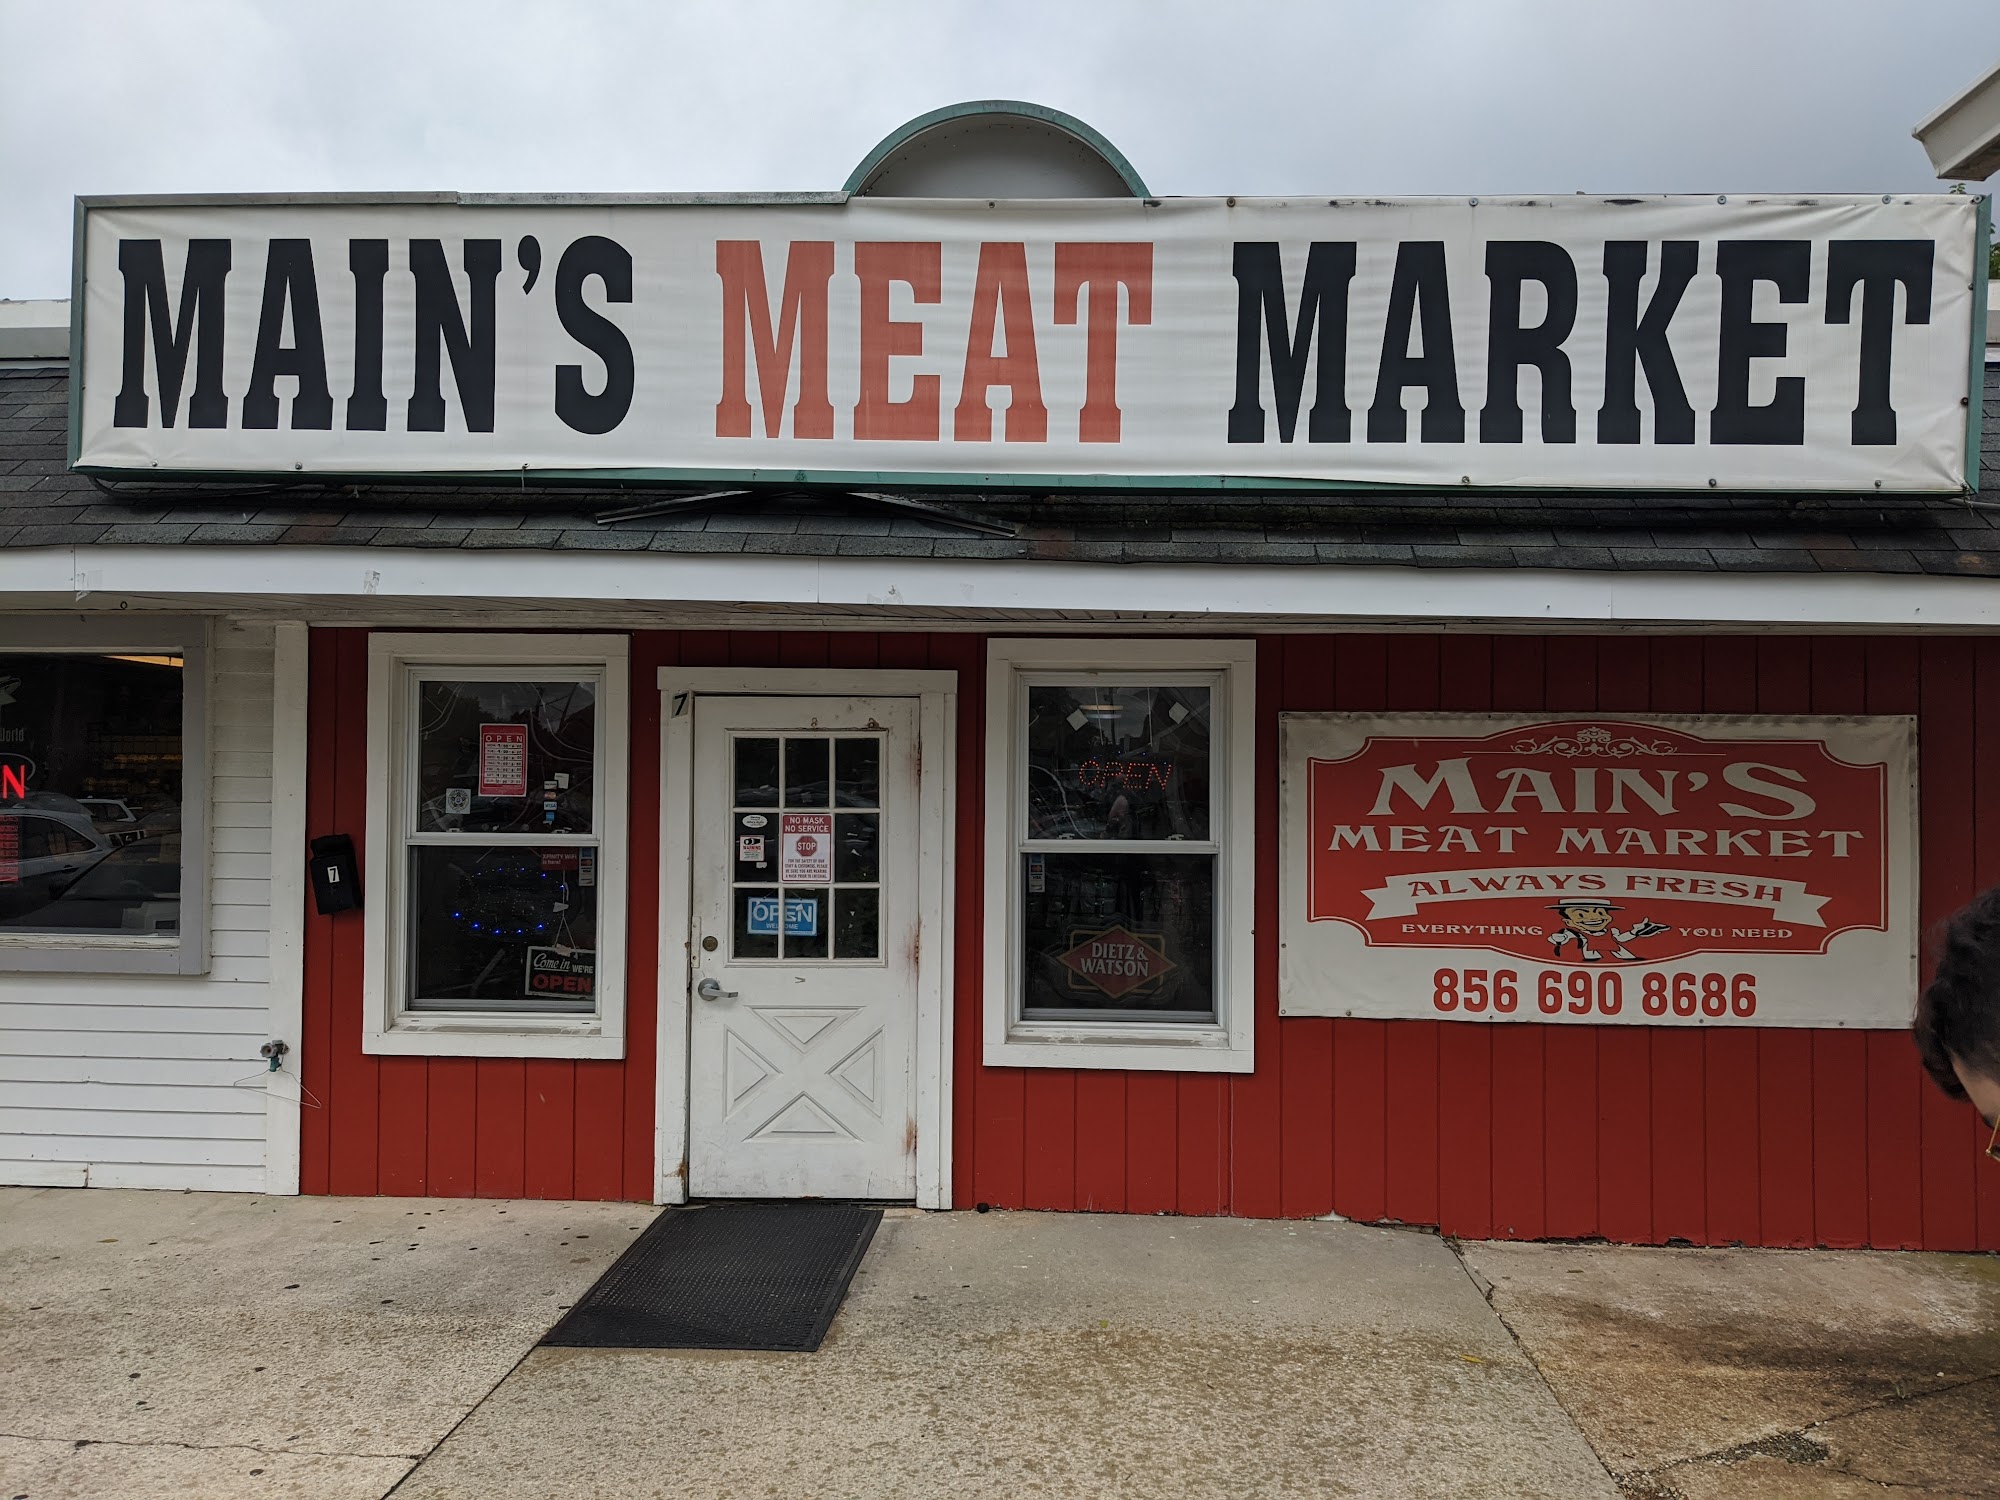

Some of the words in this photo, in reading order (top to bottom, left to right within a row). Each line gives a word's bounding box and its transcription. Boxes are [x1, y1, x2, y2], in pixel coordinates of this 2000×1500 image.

[114, 235, 635, 435] MAIN'S
[715, 239, 1154, 443] MEAT
[1227, 239, 1935, 446] MARKET
[674, 693, 688, 717] 7
[486, 735, 523, 743] OPEN
[1078, 760, 1172, 791] OPEN
[785, 825, 796, 833] NO
[798, 825, 829, 833] SERVICE
[803, 817, 824, 825] MASK
[797, 842, 816, 850] STOP
[1328, 825, 1529, 855] MEAT
[1555, 827, 1865, 858] MARKET
[329, 868, 337, 881] 7
[1408, 874, 1606, 897] ALWAYS
[1626, 875, 1783, 902] FRESH
[752, 904, 813, 923] OPEN
[766, 922, 799, 930] WELOME
[1402, 924, 1543, 936] EVERYTHING
[1679, 928, 1723, 938] YOU
[1732, 928, 1793, 938] NEED
[1092, 942, 1135, 960] DIETZ
[1137, 946, 1149, 961] &
[533, 953, 560, 968] Come
[560, 958, 571, 970] in
[572, 964, 594, 974] WE'RE
[1080, 958, 1149, 978] WATSON
[533, 974, 593, 993] OPEN
[1433, 968, 1519, 1013] 856
[1538, 970, 1622, 1015] 690
[1642, 972, 1757, 1018] 8686
